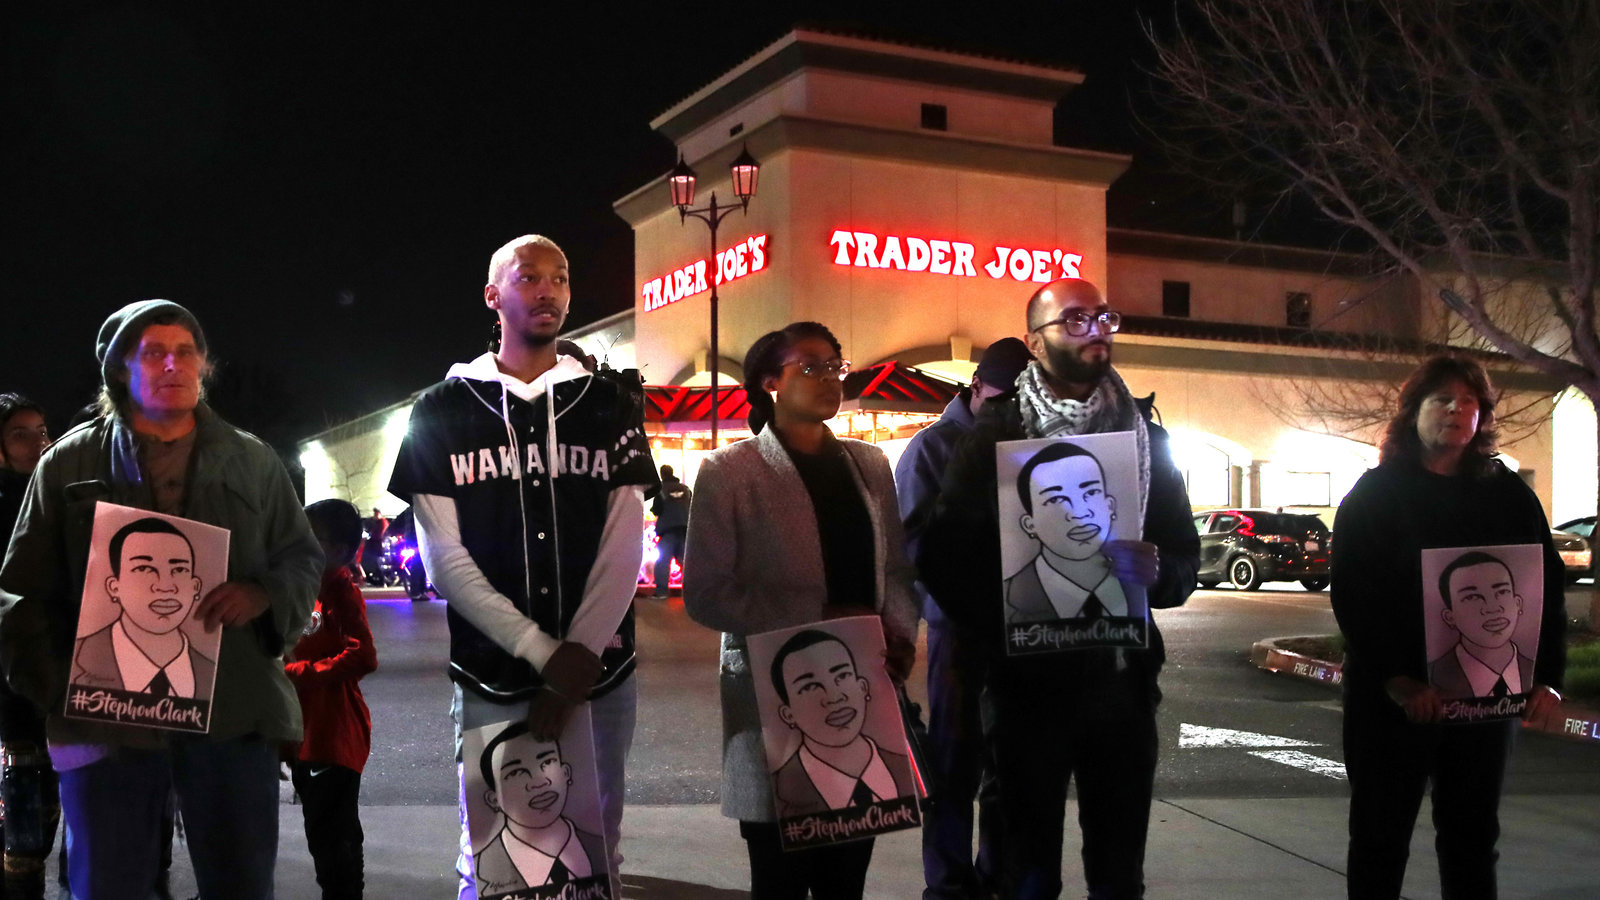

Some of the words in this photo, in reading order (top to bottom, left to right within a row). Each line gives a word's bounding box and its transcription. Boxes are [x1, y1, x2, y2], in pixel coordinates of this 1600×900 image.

[642, 259, 708, 312] TRADER
[715, 235, 766, 286] JOE'S
[830, 230, 977, 277] TRADER
[984, 246, 1083, 283] JOE'S
[1010, 618, 1142, 649] #StephonClark
[1293, 662, 1310, 675] FIRE
[71, 690, 203, 728] #StephonClark
[1564, 717, 1590, 736] FIRE
[784, 804, 918, 842] #StephonClark
